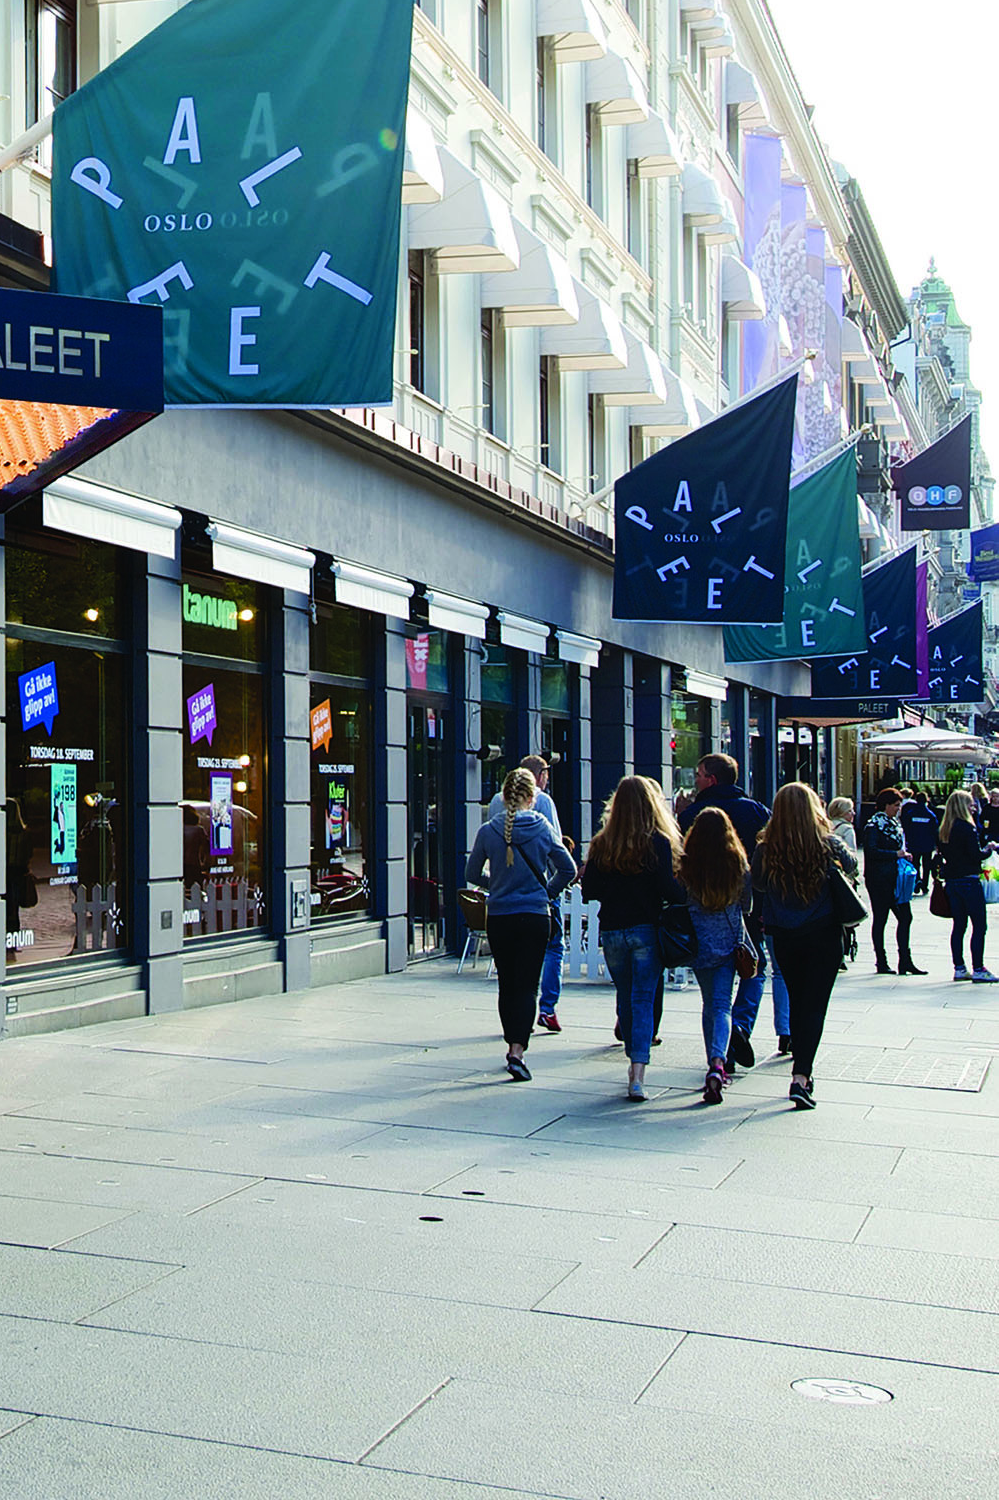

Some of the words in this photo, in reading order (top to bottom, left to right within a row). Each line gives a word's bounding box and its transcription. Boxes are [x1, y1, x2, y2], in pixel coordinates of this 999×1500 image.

[144, 212, 213, 233] OSLO
[664, 533, 700, 544] OSLO
[183, 583, 238, 631] tanum
[25, 677, 36, 697] Gå
[36, 673, 52, 692] ikke
[25, 698, 43, 722] glipp
[44, 688, 56, 707] av!
[859, 703, 889, 713] PALEET
[30, 746, 56, 759] TORSDAG
[64, 748, 94, 761] SEPTEMBER
[61, 785, 75, 801] 198
